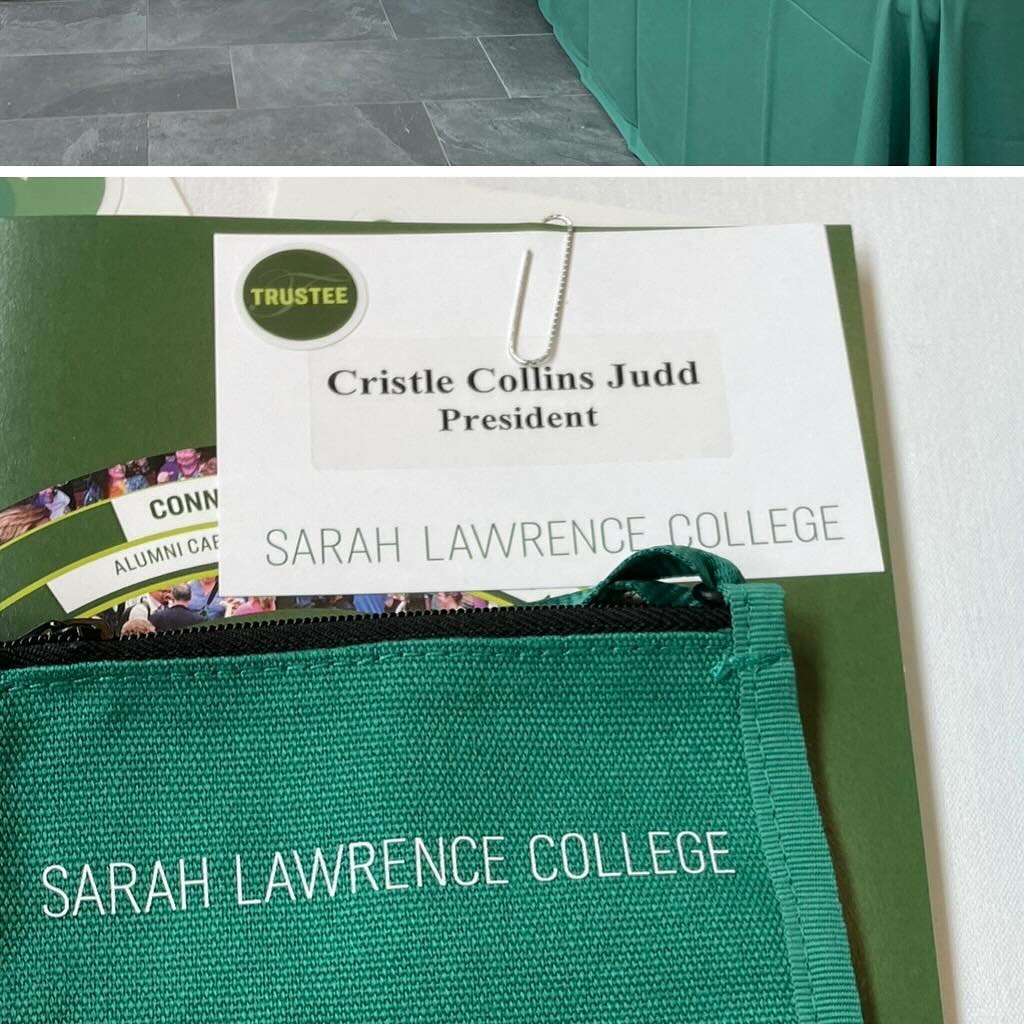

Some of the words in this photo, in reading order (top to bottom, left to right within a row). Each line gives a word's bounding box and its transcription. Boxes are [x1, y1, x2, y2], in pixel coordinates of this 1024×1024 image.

[251, 286, 350, 309] TRUSTEE
[326, 369, 455, 396] Cristle
[466, 364, 595, 394] Collins
[606, 360, 700, 391] Judd
[438, 404, 599, 432] President
[265, 526, 402, 567] SARAH
[423, 515, 648, 562] LAWRENCE
[668, 504, 846, 549] COLLEGE
[114, 541, 184, 576] ALUMNI
[41, 856, 212, 919] SARAH
[234, 835, 510, 906] LAWRENCE
[528, 830, 737, 884] COLLEGE
